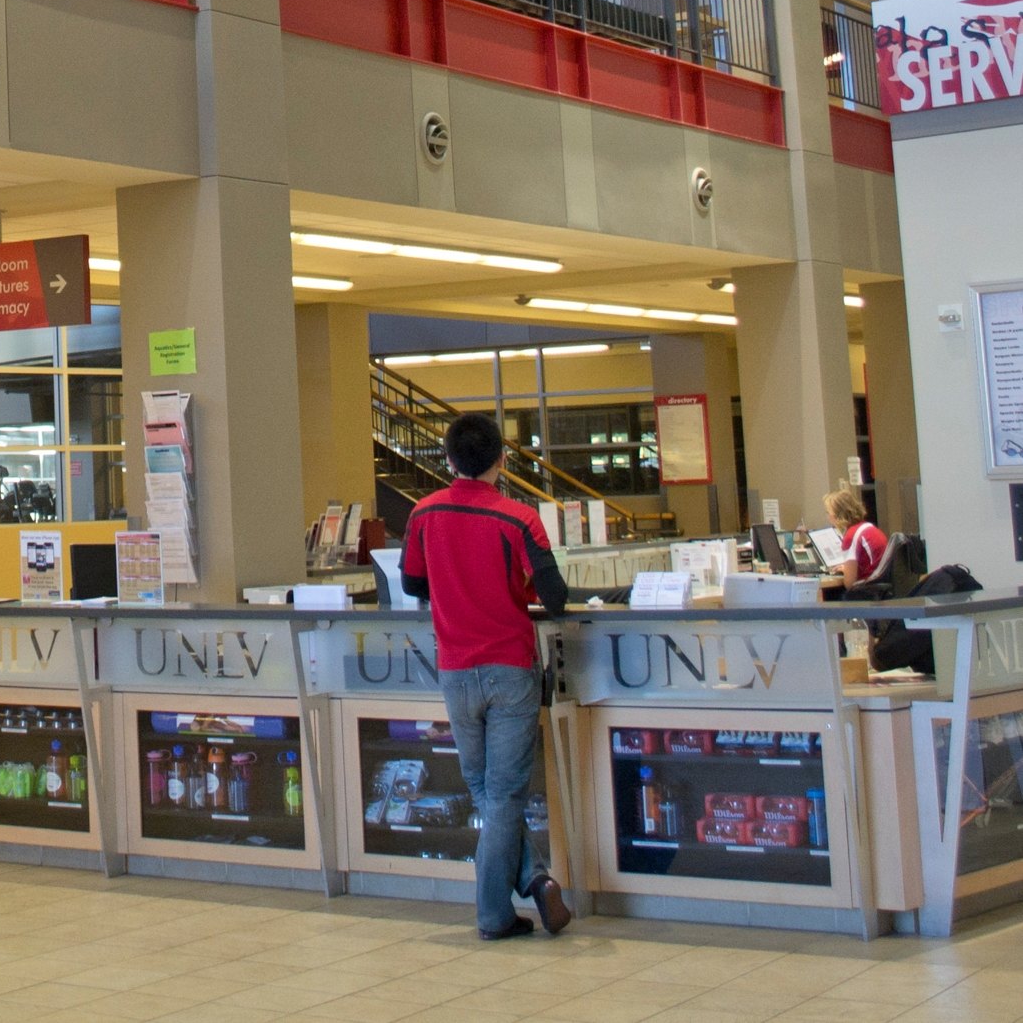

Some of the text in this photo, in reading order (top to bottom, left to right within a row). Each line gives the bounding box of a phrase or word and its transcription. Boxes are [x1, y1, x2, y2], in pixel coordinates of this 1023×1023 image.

[667, 397, 697, 405] directory
[133, 627, 275, 679] UNLV
[351, 631, 440, 684] UN
[604, 633, 791, 690] UNLV
[614, 744, 643, 754] Wilson
[671, 744, 702, 753] Wilson
[713, 809, 745, 819] Wilson
[764, 811, 796, 821] Wilson
[705, 835, 737, 844] Wilson
[754, 838, 787, 847] Wilson
